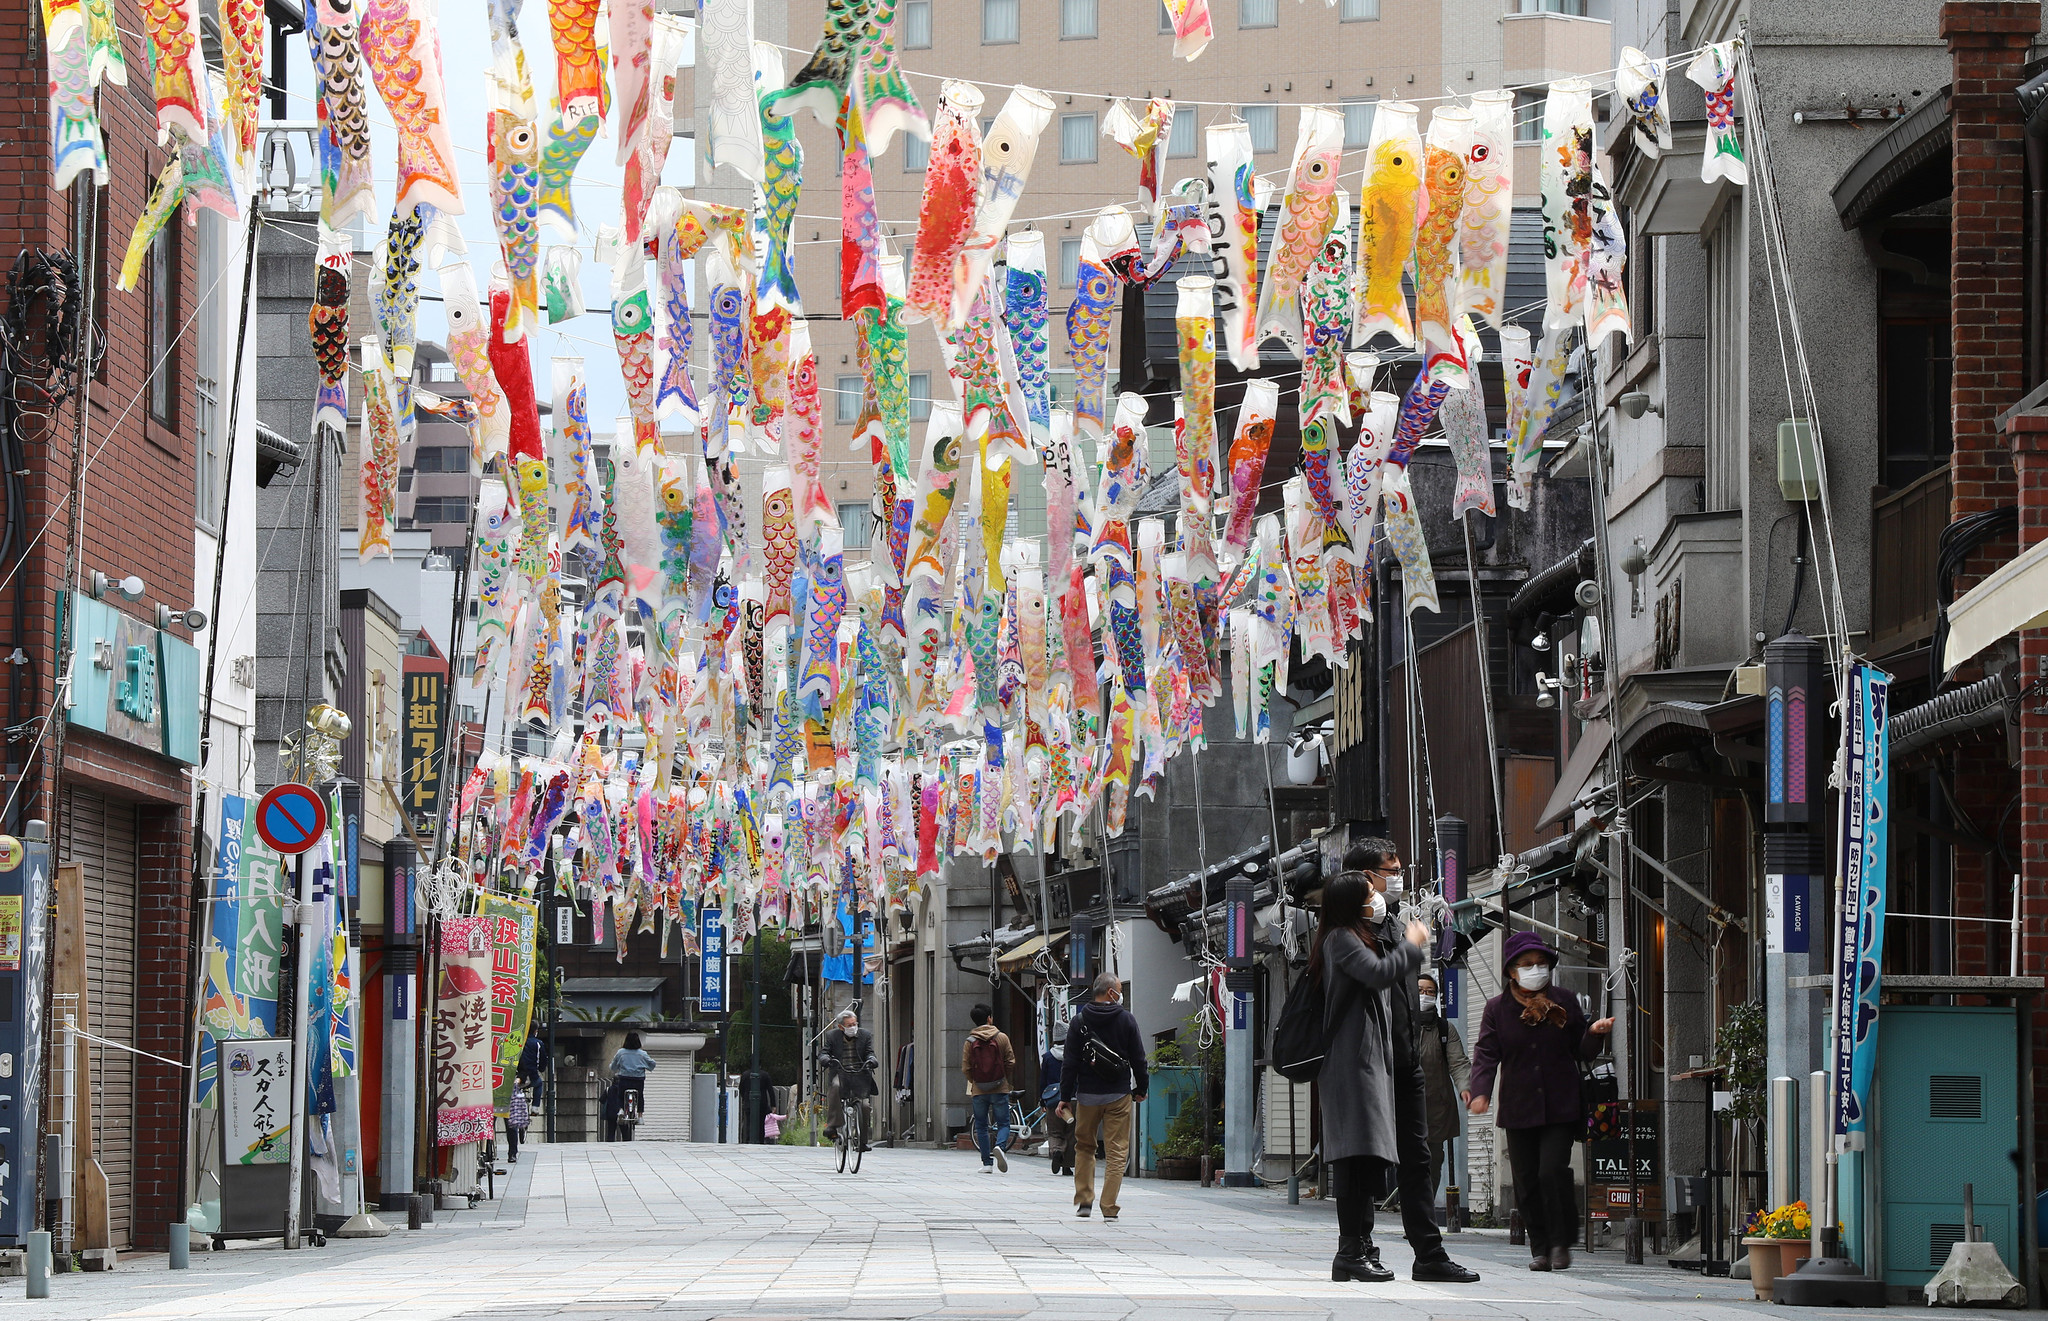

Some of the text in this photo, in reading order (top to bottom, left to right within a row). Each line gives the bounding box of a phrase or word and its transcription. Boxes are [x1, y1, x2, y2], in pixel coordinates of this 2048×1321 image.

[568, 102, 599, 119] RIE
[409, 676, 438, 807] 川越タルト
[1794, 894, 1802, 932] KAWAGOE
[1846, 848, 1860, 916] 防カビ加工
[520, 914, 536, 1002] 驚きのテイスト
[705, 916, 721, 993] 中野歯科
[437, 1008, 461, 1109] ようかん
[459, 995, 488, 1051] 焼芋
[1840, 925, 1856, 1128] 徹底した衛生加工で安心
[252, 1058, 275, 1152] スガ人形店
[1596, 1158, 1651, 1171] TALX
[1610, 1191, 1640, 1204] CHUS
